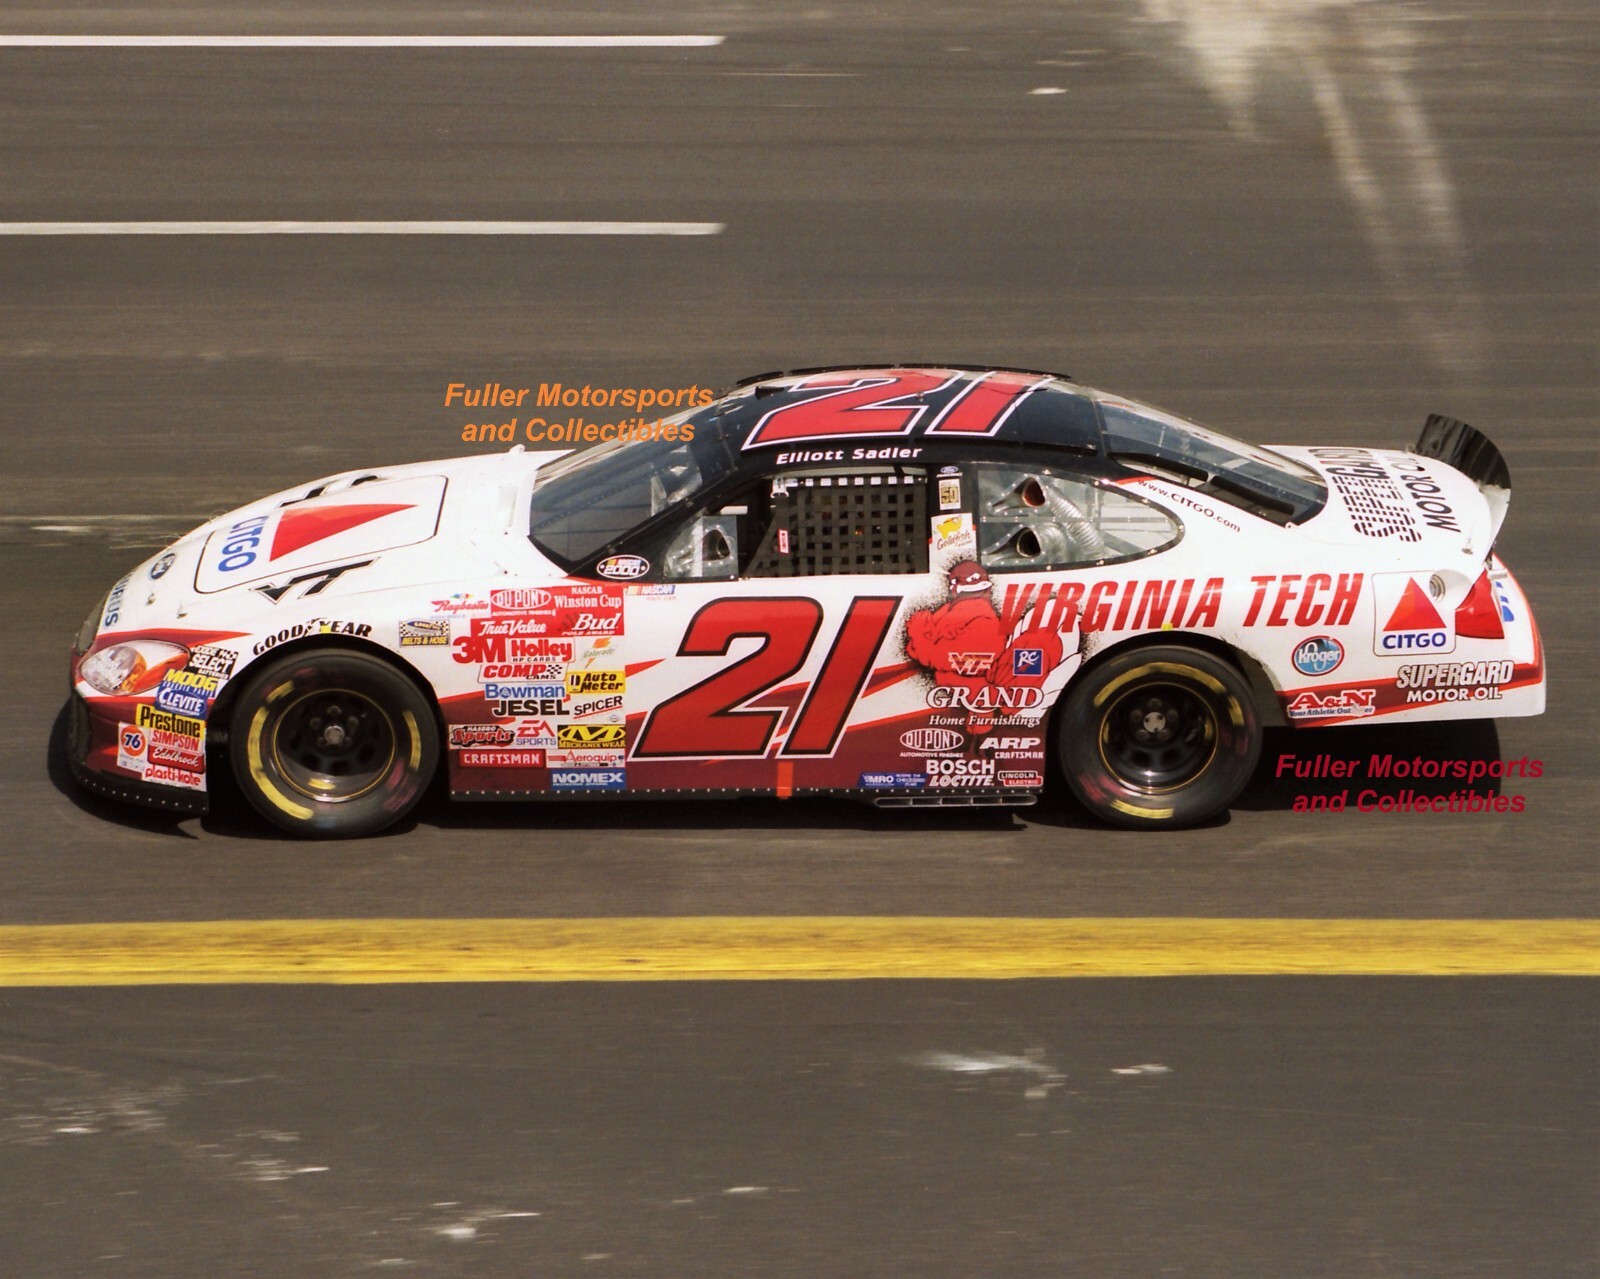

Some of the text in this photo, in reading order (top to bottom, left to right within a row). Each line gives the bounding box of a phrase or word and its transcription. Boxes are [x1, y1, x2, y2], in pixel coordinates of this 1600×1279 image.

[741, 370, 1056, 451] 21
[776, 447, 922, 465] Elliott Sadler
[1138, 480, 1241, 533] www.CITGO.com
[1400, 475, 1462, 533] MOTOR
[218, 516, 269, 572] CITGO
[604, 566, 640, 576] 2000
[571, 586, 602, 594] NASCAR
[641, 585, 672, 594] NASCAR
[554, 594, 622, 609] Winston Cup
[1000, 573, 1365, 634] VIRGINIA TECH
[572, 613, 622, 630] Bud
[253, 617, 373, 656] GOODYEAR
[402, 637, 421, 645] BELTS
[429, 636, 448, 645] HOSE
[1382, 632, 1446, 649] CITGO
[452, 635, 506, 664] 3M
[511, 639, 572, 662] Holley
[1298, 642, 1340, 671] Kroger
[189, 653, 233, 673] SELECT
[483, 664, 547, 678] COMP
[163, 668, 218, 692] MOOG
[584, 673, 617, 682] Auto
[628, 595, 904, 762] 21
[1396, 660, 1515, 688] SUPERGARD
[485, 683, 566, 699] Bowman
[581, 681, 624, 690] Meter
[159, 688, 205, 712] CLEVITE
[927, 686, 1044, 713] GRAND
[1406, 687, 1502, 703] MOTOR OIL
[493, 700, 570, 715] JESEL
[574, 695, 623, 716] SPICER
[1307, 708, 1336, 716] Athletic
[140, 705, 201, 738] Prestone
[929, 715, 1041, 728] Home Furnishings
[124, 733, 141, 749] 76
[152, 729, 199, 751] SIMPSON
[452, 727, 511, 744] Sports
[979, 737, 1041, 749] ARP
[464, 753, 540, 765] CRAFTSMAN
[566, 749, 617, 763] Aeroquip
[994, 751, 1044, 759] CRAFTSMAN
[145, 765, 201, 786] plasti-kote
[926, 760, 995, 775] BOSCH
[552, 772, 624, 783] NOMEX
